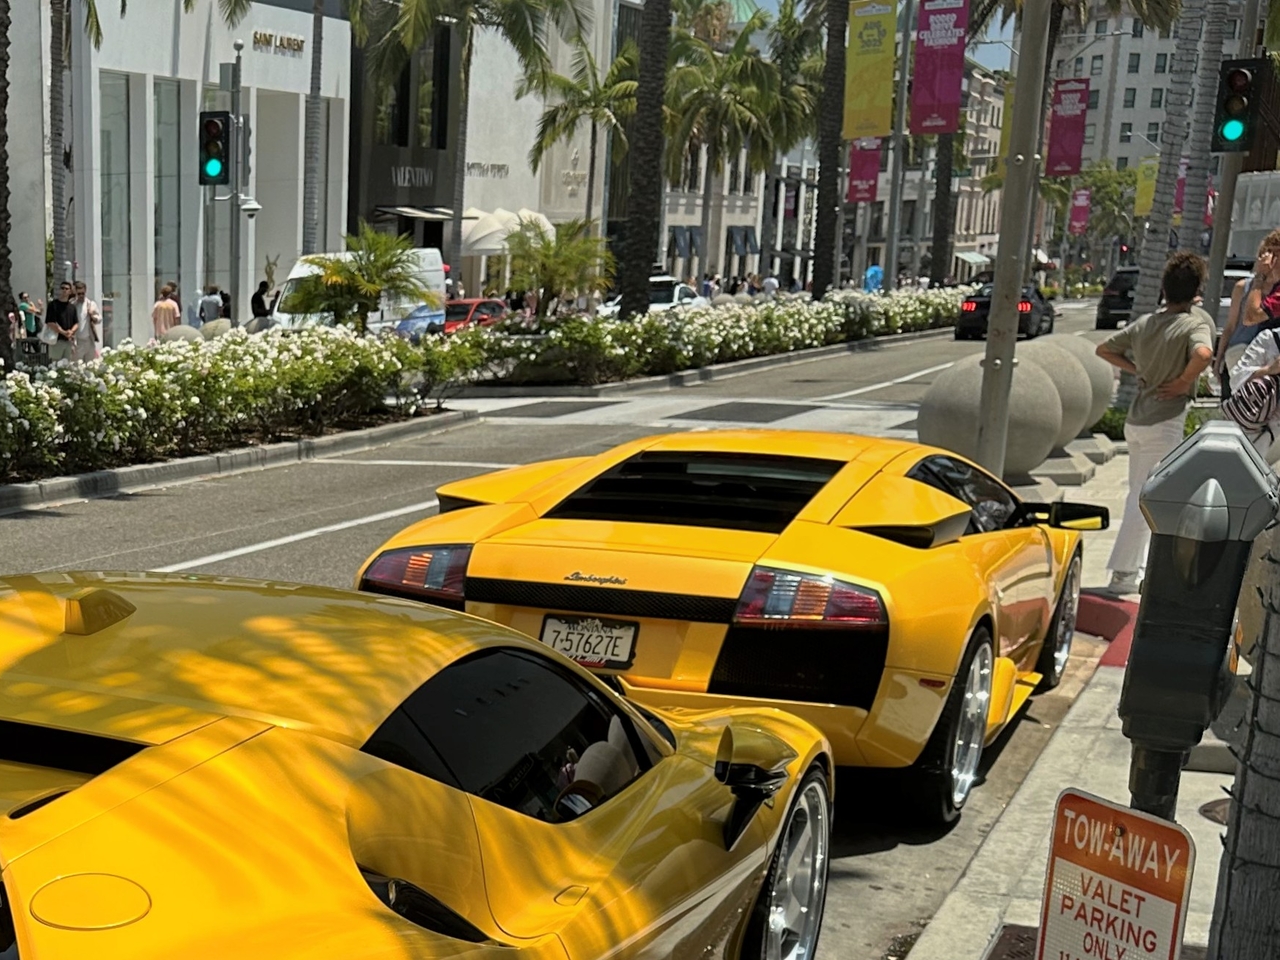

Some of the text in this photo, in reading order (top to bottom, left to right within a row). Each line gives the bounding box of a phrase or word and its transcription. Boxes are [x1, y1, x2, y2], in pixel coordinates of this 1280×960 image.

[253, 31, 305, 52] SAINT LAURENT
[564, 571, 628, 586] Lamborghini
[566, 623, 614, 636] MONTANA
[1063, 808, 1181, 883] TOW-AWAY
[1080, 871, 1147, 919] VALET
[1059, 893, 1158, 953] PARKING
